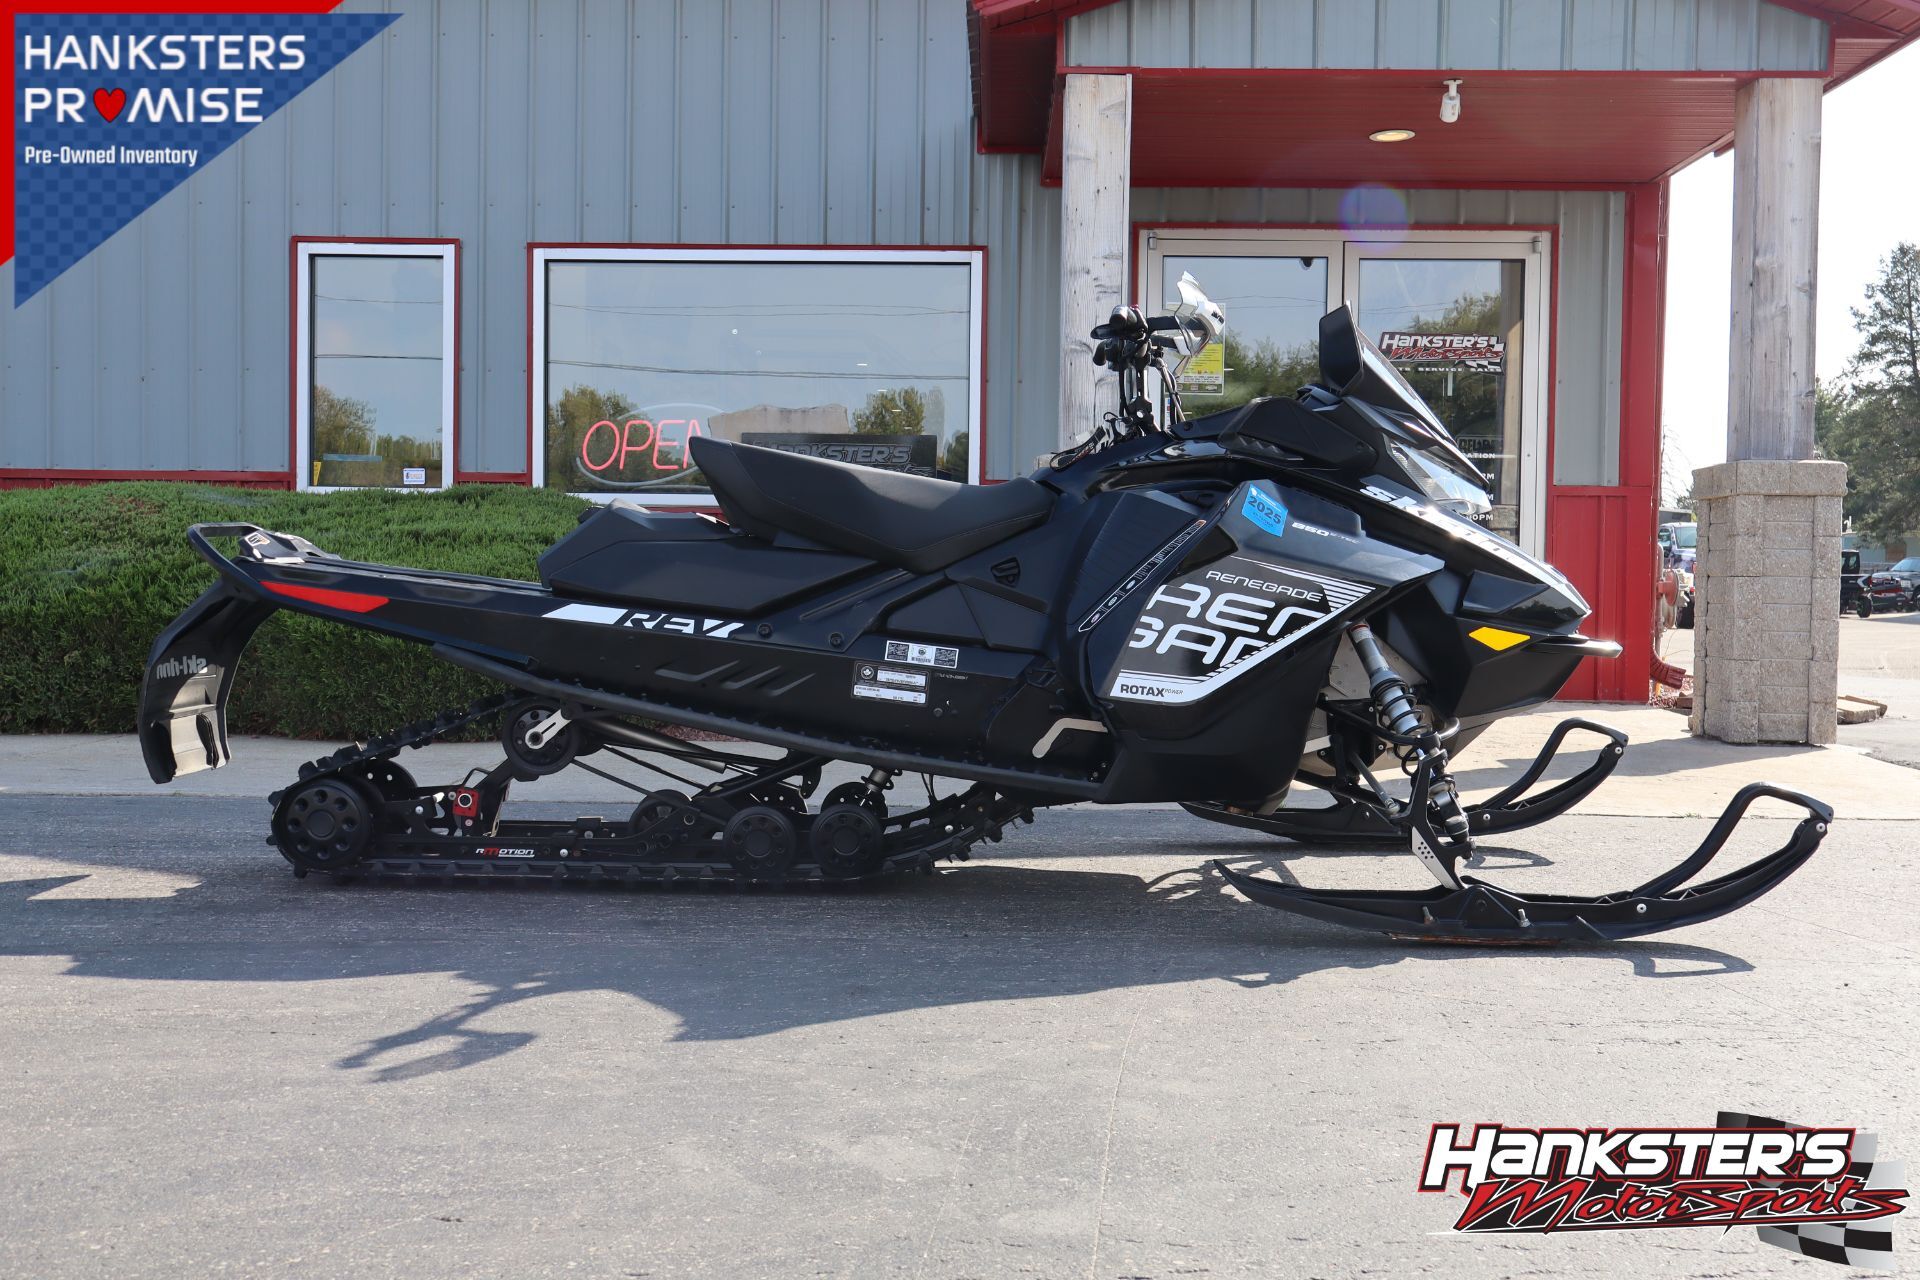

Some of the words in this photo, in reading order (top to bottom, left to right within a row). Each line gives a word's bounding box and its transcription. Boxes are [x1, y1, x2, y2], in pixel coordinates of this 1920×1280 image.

[1247, 495, 1282, 525] 2025
[1205, 570, 1324, 603] RENEGADE
[622, 612, 745, 639] REV
[1120, 683, 1165, 698] ROTAX
[1164, 687, 1184, 695] POWER
